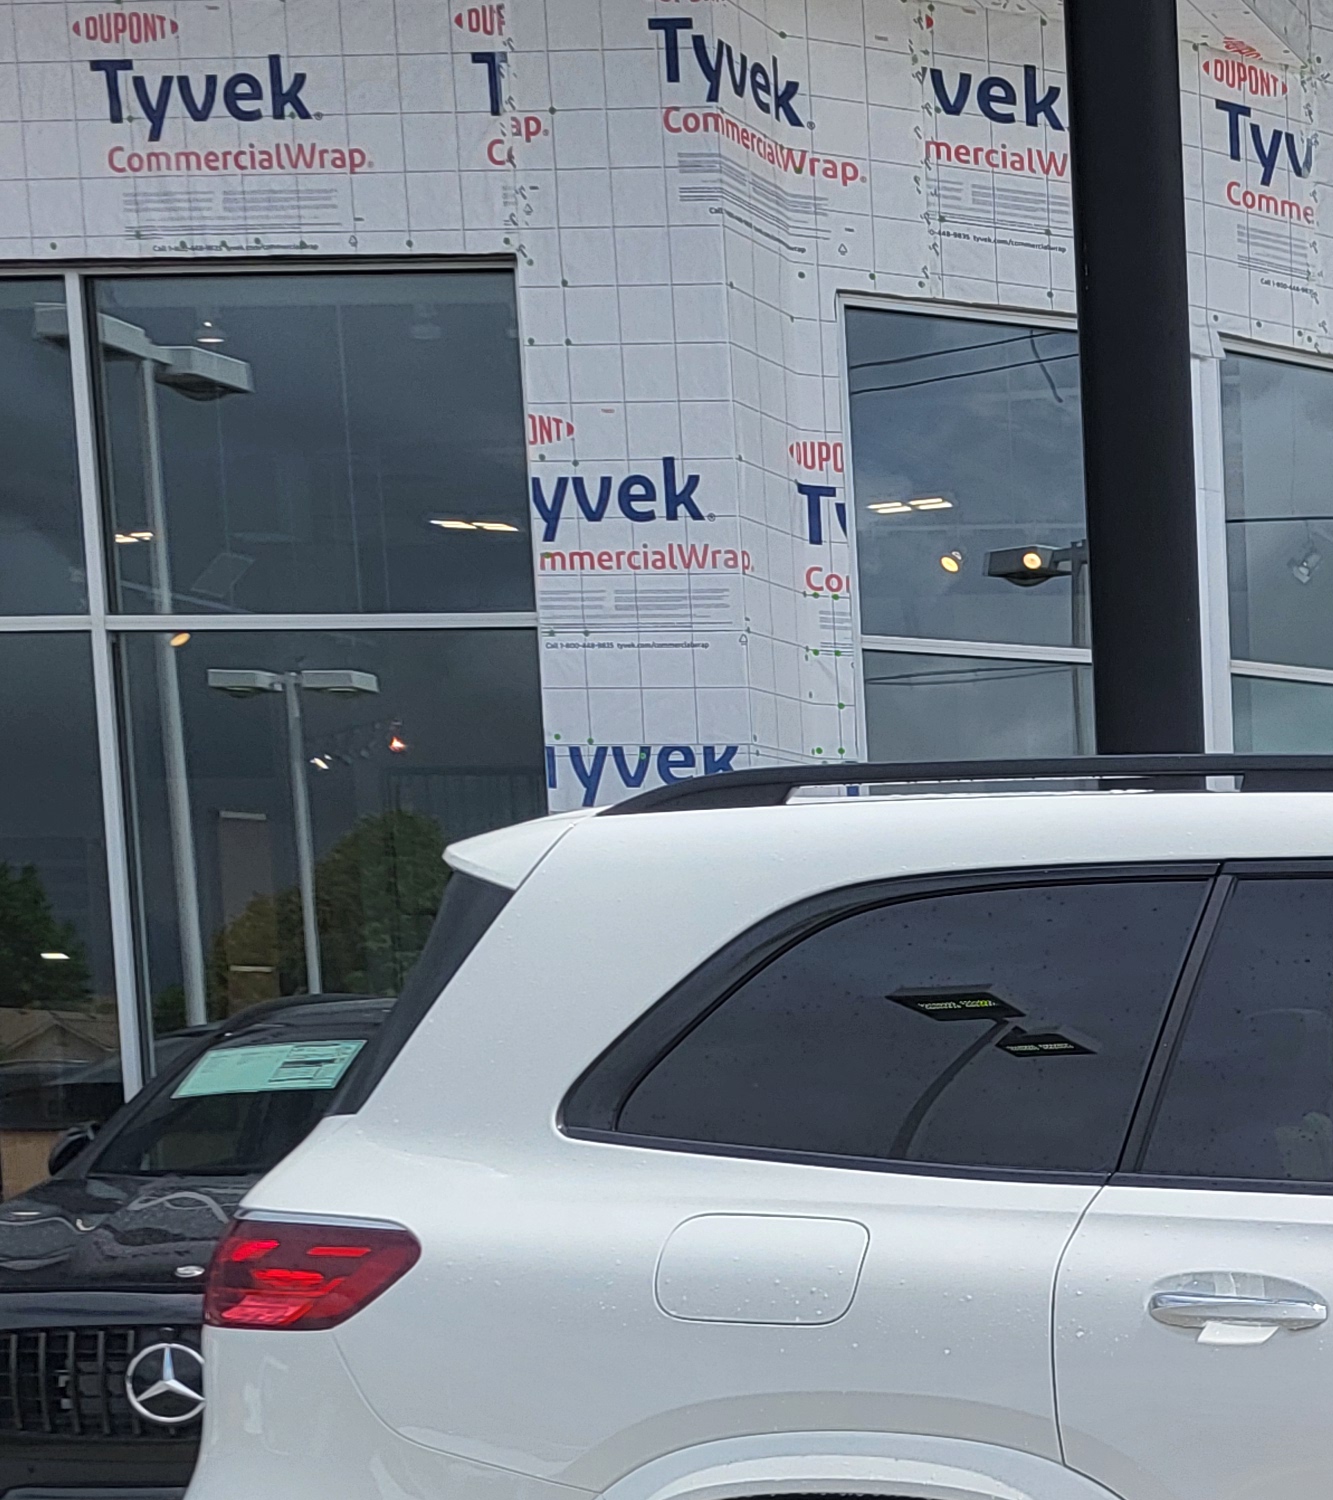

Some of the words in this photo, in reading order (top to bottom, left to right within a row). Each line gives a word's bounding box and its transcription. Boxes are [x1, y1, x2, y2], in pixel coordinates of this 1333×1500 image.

[85, 11, 166, 44] DUPONT
[648, 17, 805, 128] Tyvek
[1214, 59, 1279, 98] DUPONT
[89, 54, 313, 142] Tyvek
[108, 143, 366, 175] CommercialWrap
[663, 106, 859, 186] CommercialWrap
[1215, 99, 1312, 187] Tyv
[1226, 181, 1314, 224] Comme
[532, 456, 705, 542] yvek
[540, 543, 751, 575] mmercialWrap
[806, 566, 850, 593] Co
